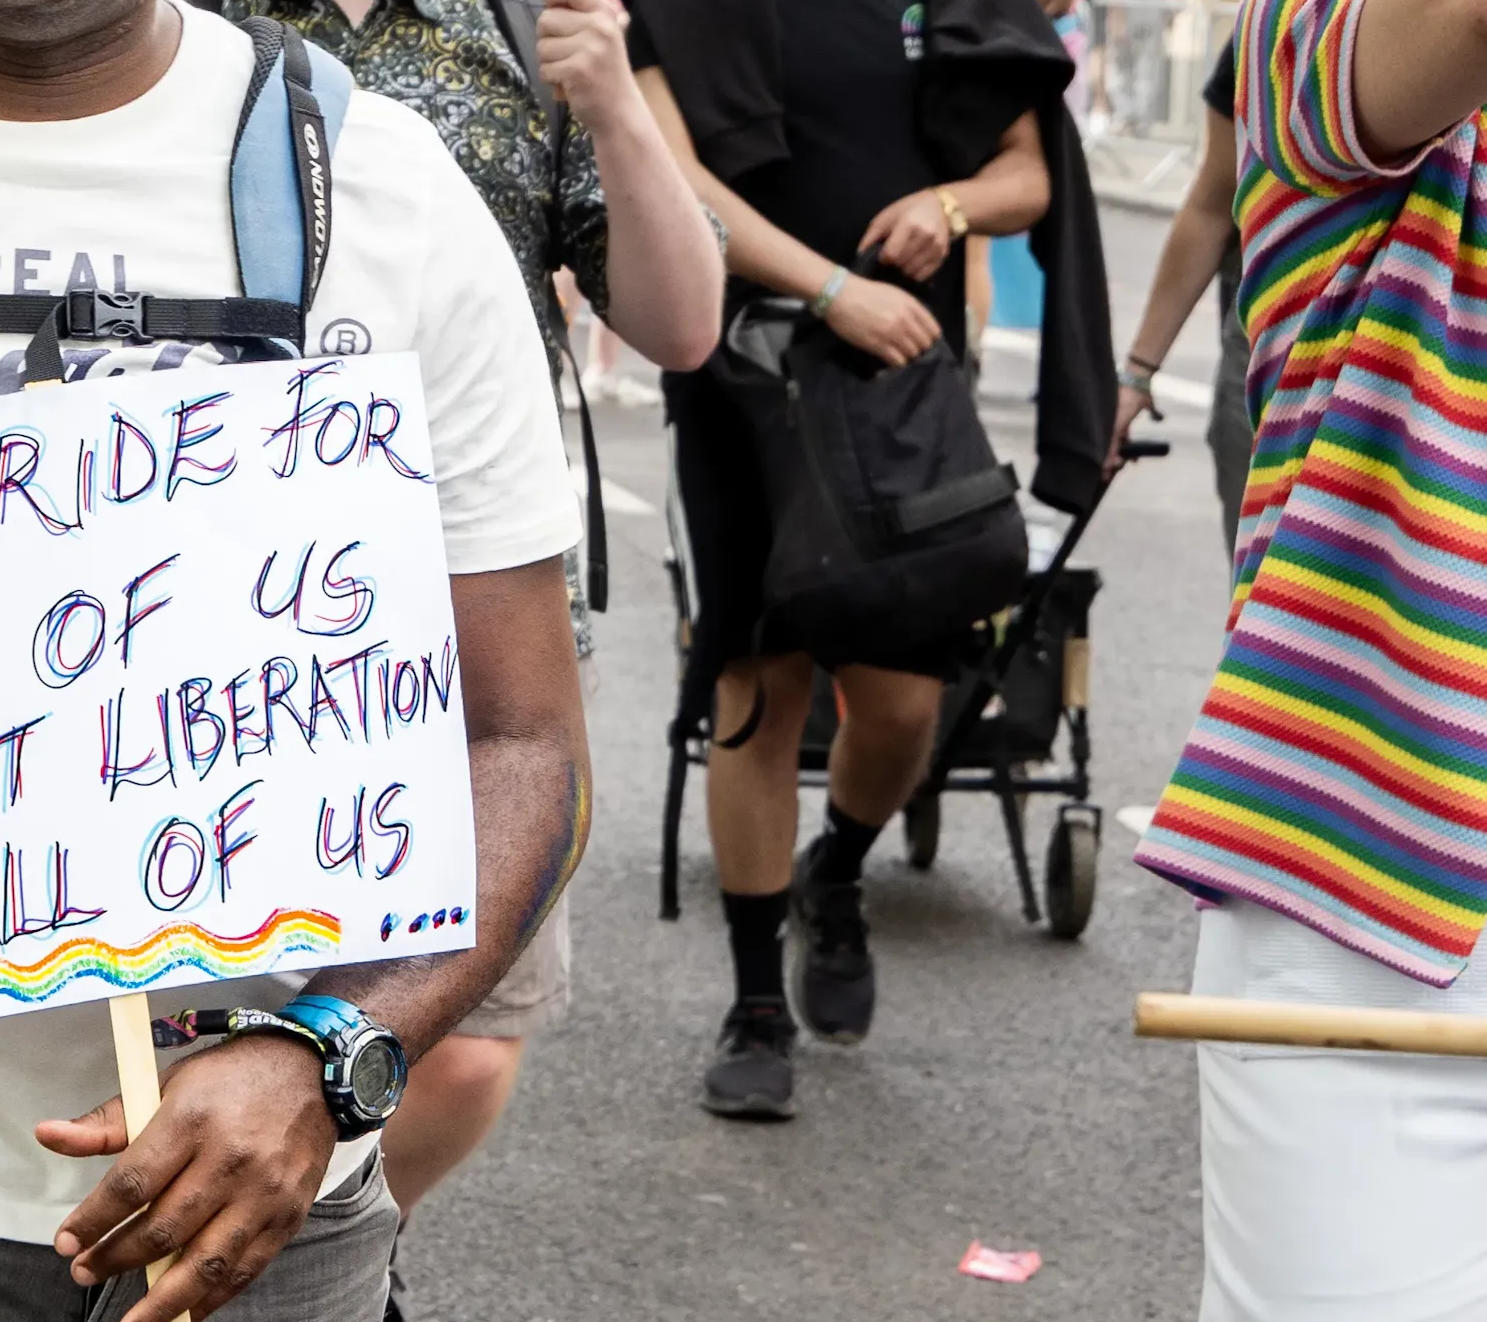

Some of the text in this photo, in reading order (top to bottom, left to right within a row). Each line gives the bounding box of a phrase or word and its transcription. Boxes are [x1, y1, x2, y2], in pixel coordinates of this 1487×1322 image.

[260, 360, 436, 482] FOR
[31, 552, 181, 689] OF
[250, 540, 377, 638] US
[98, 634, 458, 801] LIBERATION
[138, 779, 265, 913] OF
[315, 781, 416, 881] US
